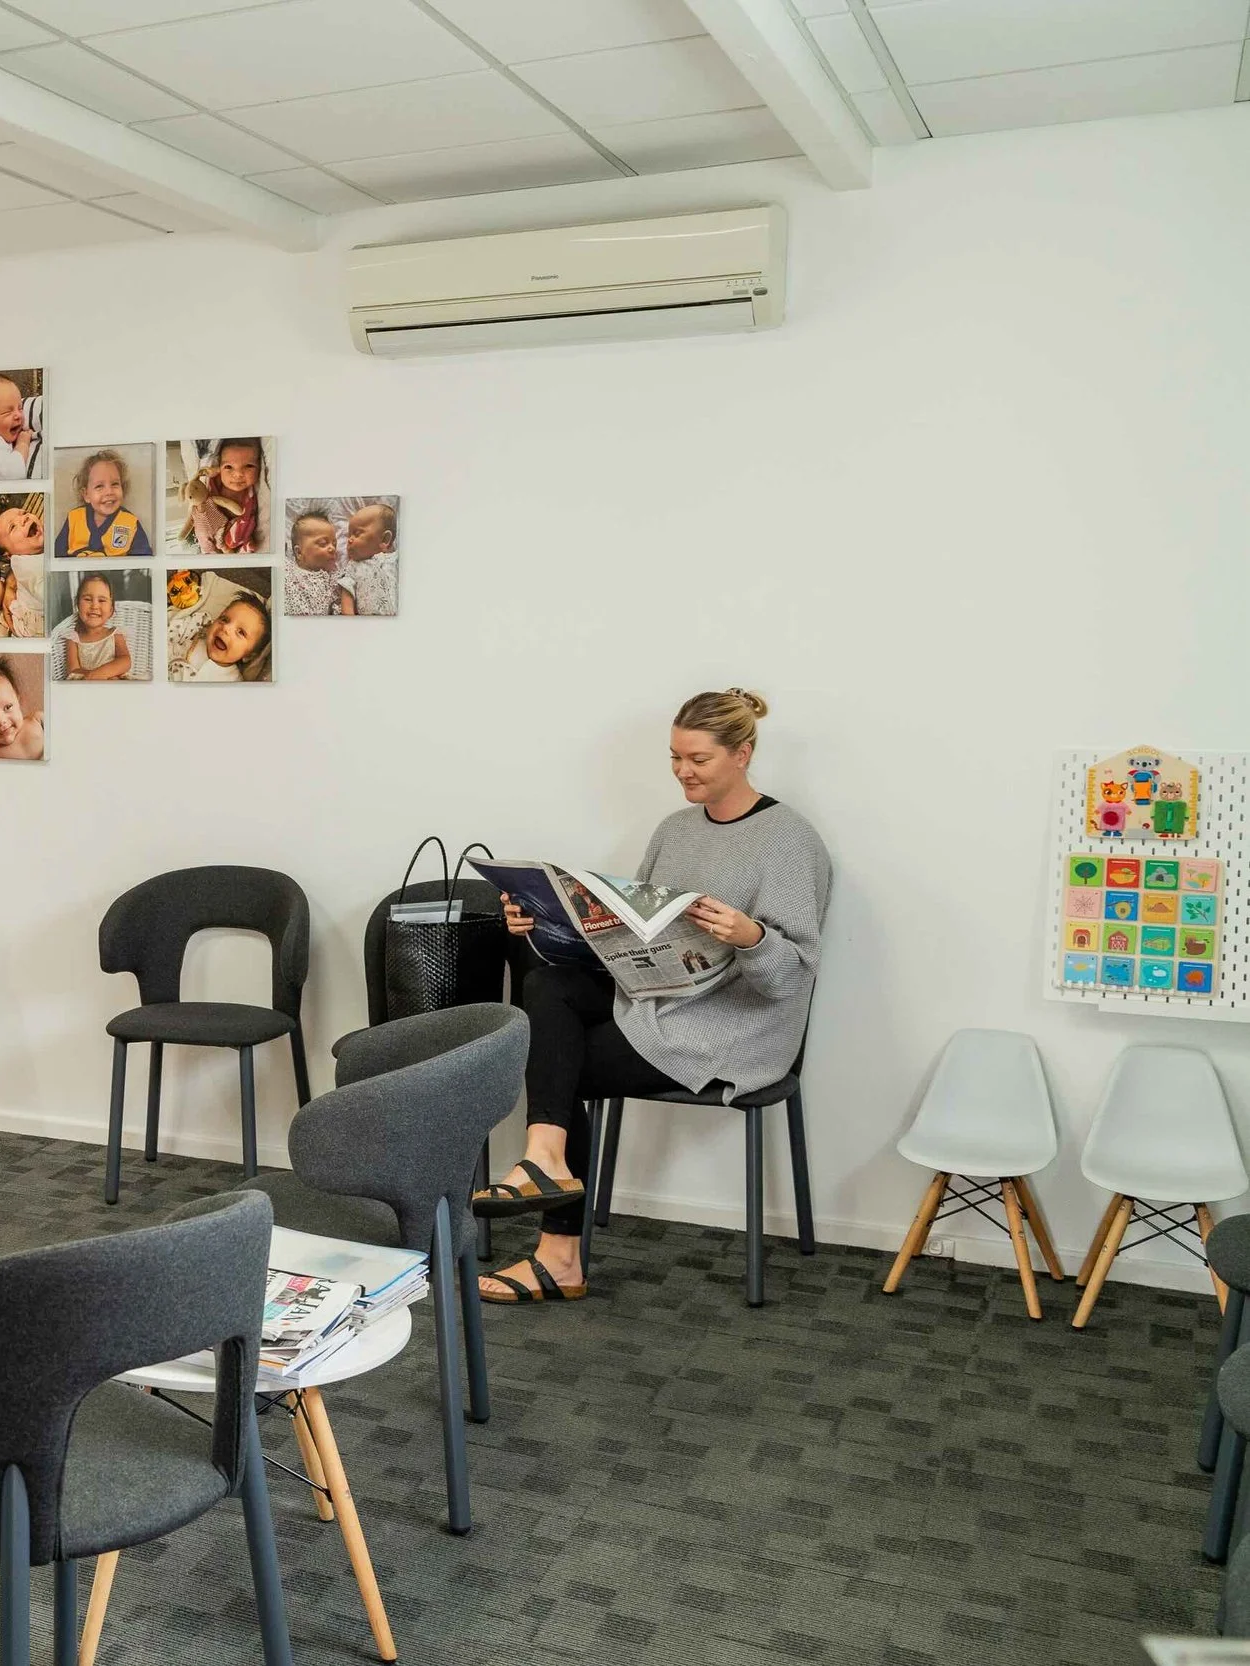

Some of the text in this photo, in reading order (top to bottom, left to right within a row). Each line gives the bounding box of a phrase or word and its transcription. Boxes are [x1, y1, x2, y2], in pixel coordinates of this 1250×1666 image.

[584, 918, 614, 931] Floreat
[604, 943, 672, 962] Spike their guns
